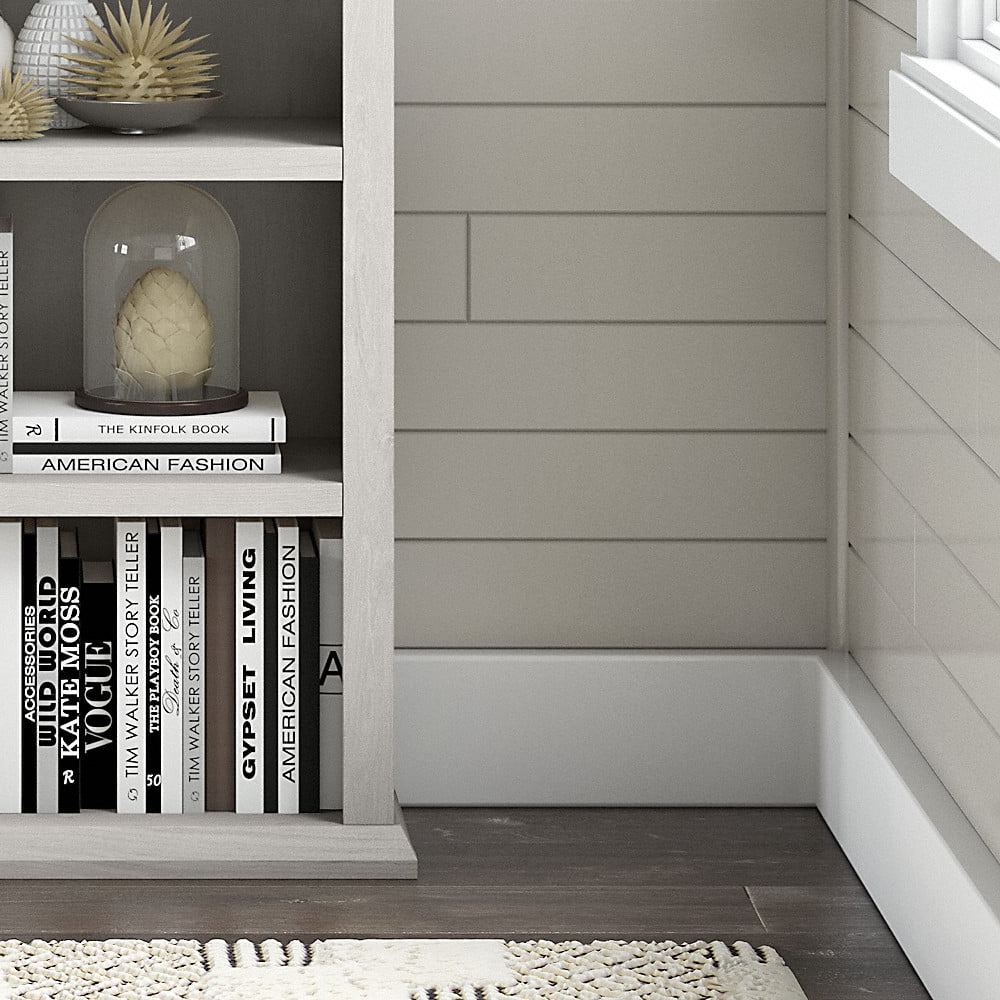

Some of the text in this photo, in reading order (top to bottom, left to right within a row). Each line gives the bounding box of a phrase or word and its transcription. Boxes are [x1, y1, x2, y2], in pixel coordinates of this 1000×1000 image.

[41, 458, 264, 471] AMERICAN FASHION
[98, 425, 229, 434] THE KINFOLK BOOK
[24, 605, 36, 722] ACCESSORIES
[38, 576, 57, 747] WILD WORLD
[60, 586, 80, 759] KATE MOSS
[84, 641, 113, 754] VOGUE
[125, 531, 139, 777] TIM WALKER STORY TELLER
[149, 595, 160, 733] THE PLAYBOY BOOK
[162, 655, 180, 716] Death
[189, 576, 200, 782] TIM WALKER STORY TELLER
[242, 548, 256, 780] GYPSET LIVING
[282, 545, 295, 783] AMERICAN FASHION
[146, 774, 161, 786] 50
